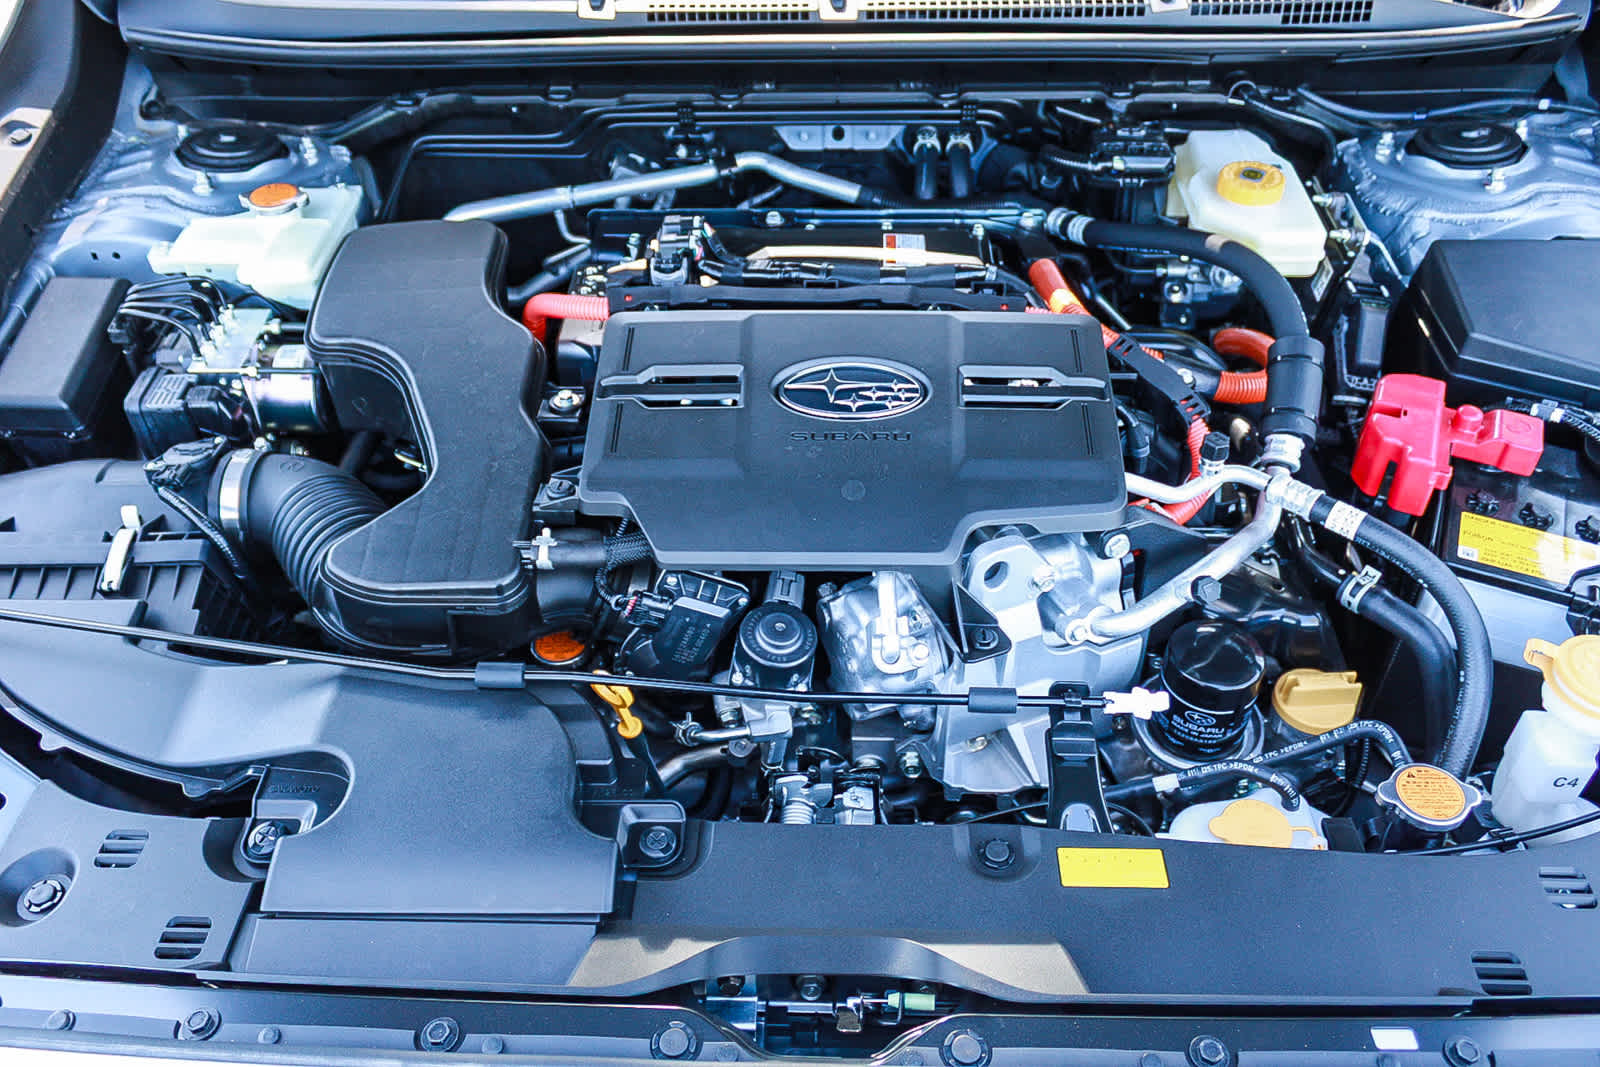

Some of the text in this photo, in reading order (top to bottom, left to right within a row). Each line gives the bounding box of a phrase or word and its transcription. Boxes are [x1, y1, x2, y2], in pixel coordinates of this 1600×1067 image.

[791, 431, 911, 441] SUBARU
[1172, 714, 1225, 734] SUBARU
[1553, 776, 1579, 788] C4
